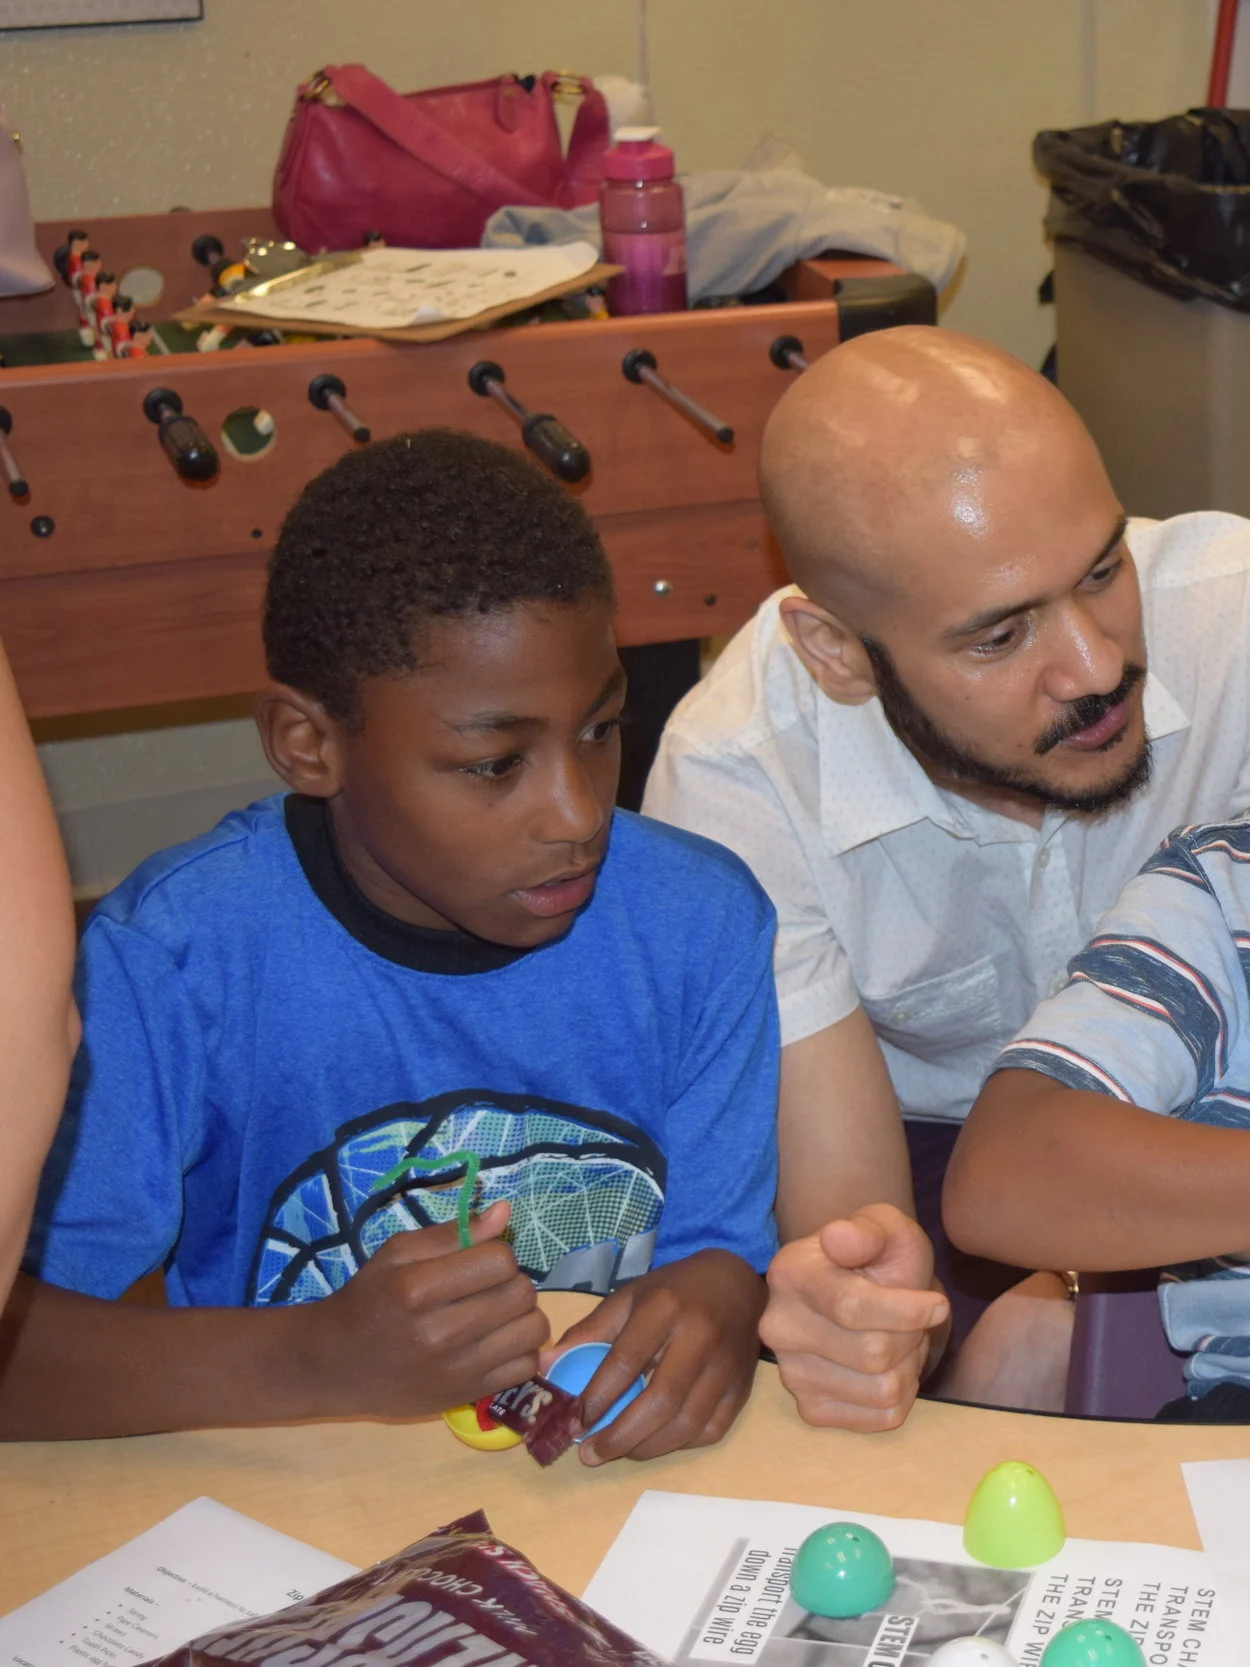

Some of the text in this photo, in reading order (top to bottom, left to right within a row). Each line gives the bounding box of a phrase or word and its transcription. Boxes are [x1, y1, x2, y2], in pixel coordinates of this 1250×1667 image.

[286, 1588, 304, 1602] Zip
[702, 1550, 772, 1645] down a zip wire
[1042, 1574, 1069, 1605] THE
[1135, 1582, 1161, 1613] THE
[472, 1597, 538, 1635] MILK
[746, 1607, 778, 1628] the
[1032, 1610, 1055, 1636] ZIP
[1187, 1588, 1216, 1632] STEM
[874, 1616, 915, 1658] STEM
[1150, 1586, 1188, 1666] TRANSPO
[730, 1631, 762, 1655] egg
